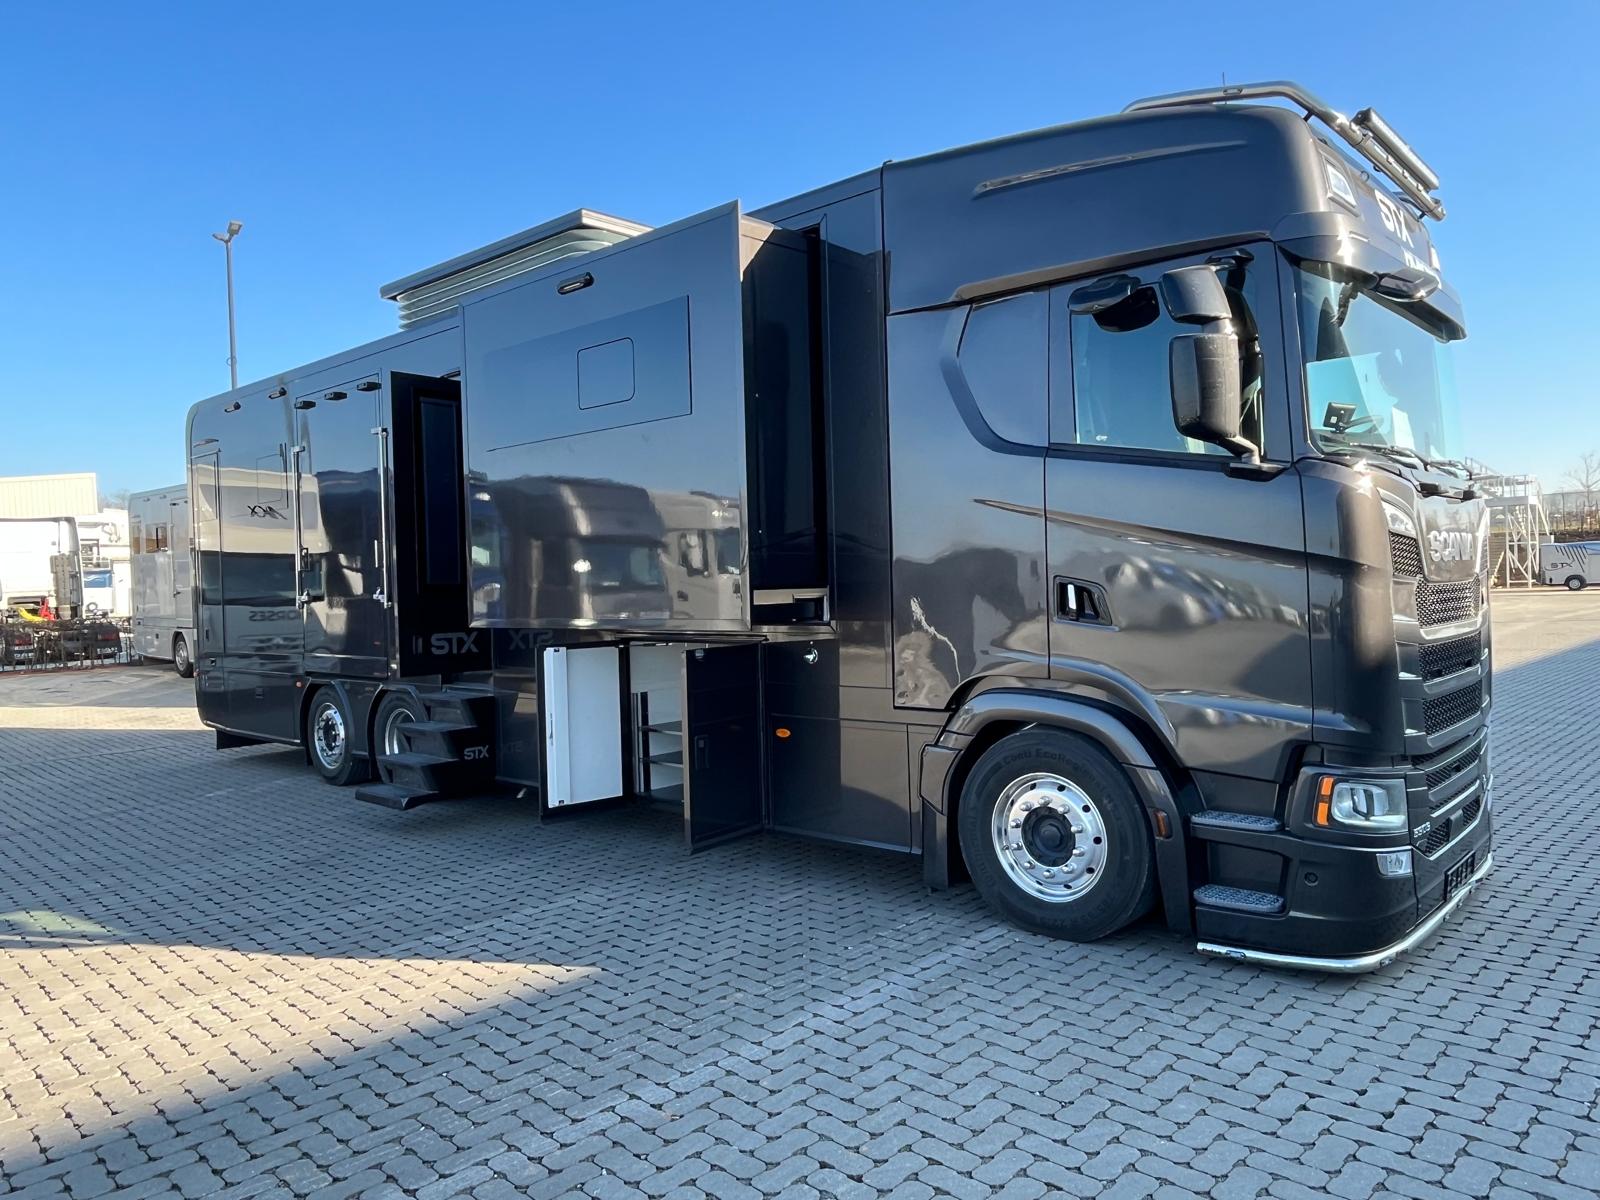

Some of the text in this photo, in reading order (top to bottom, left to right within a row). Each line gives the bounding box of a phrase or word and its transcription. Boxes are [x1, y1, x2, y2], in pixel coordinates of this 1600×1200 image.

[1374, 189, 1414, 248] STX
[430, 631, 479, 655] STX
[464, 745, 489, 760] STX
